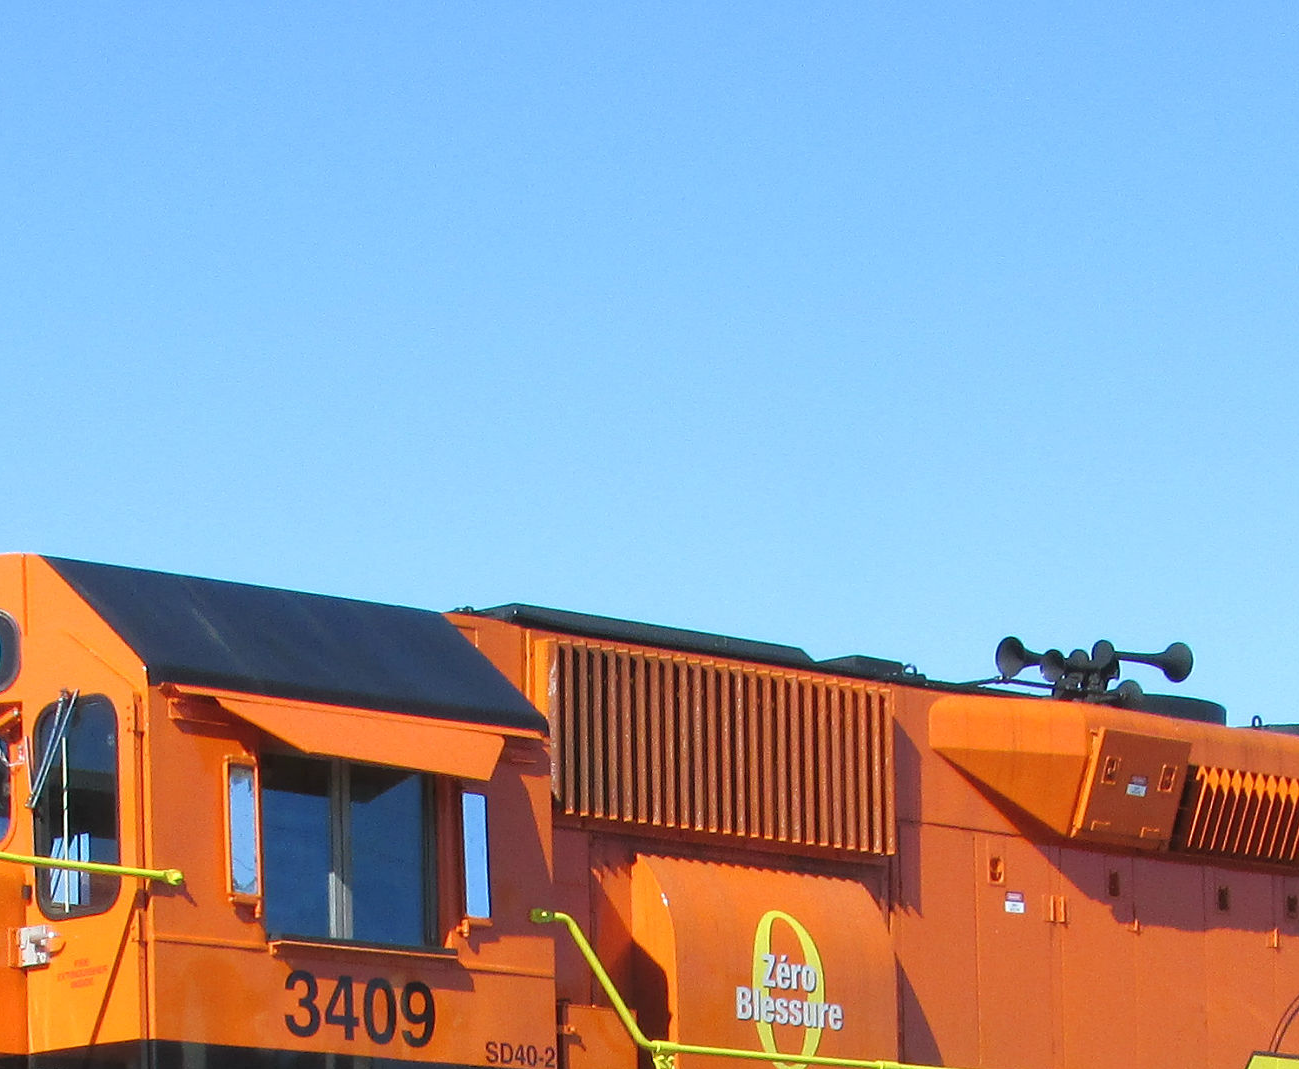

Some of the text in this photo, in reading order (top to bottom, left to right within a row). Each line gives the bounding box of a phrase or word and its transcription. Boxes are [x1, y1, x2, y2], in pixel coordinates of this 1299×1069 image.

[762, 953, 817, 993] Zéro
[284, 970, 435, 1048] 3409
[735, 986, 845, 1031] Blessure
[485, 1041, 557, 1068] SD40-2
